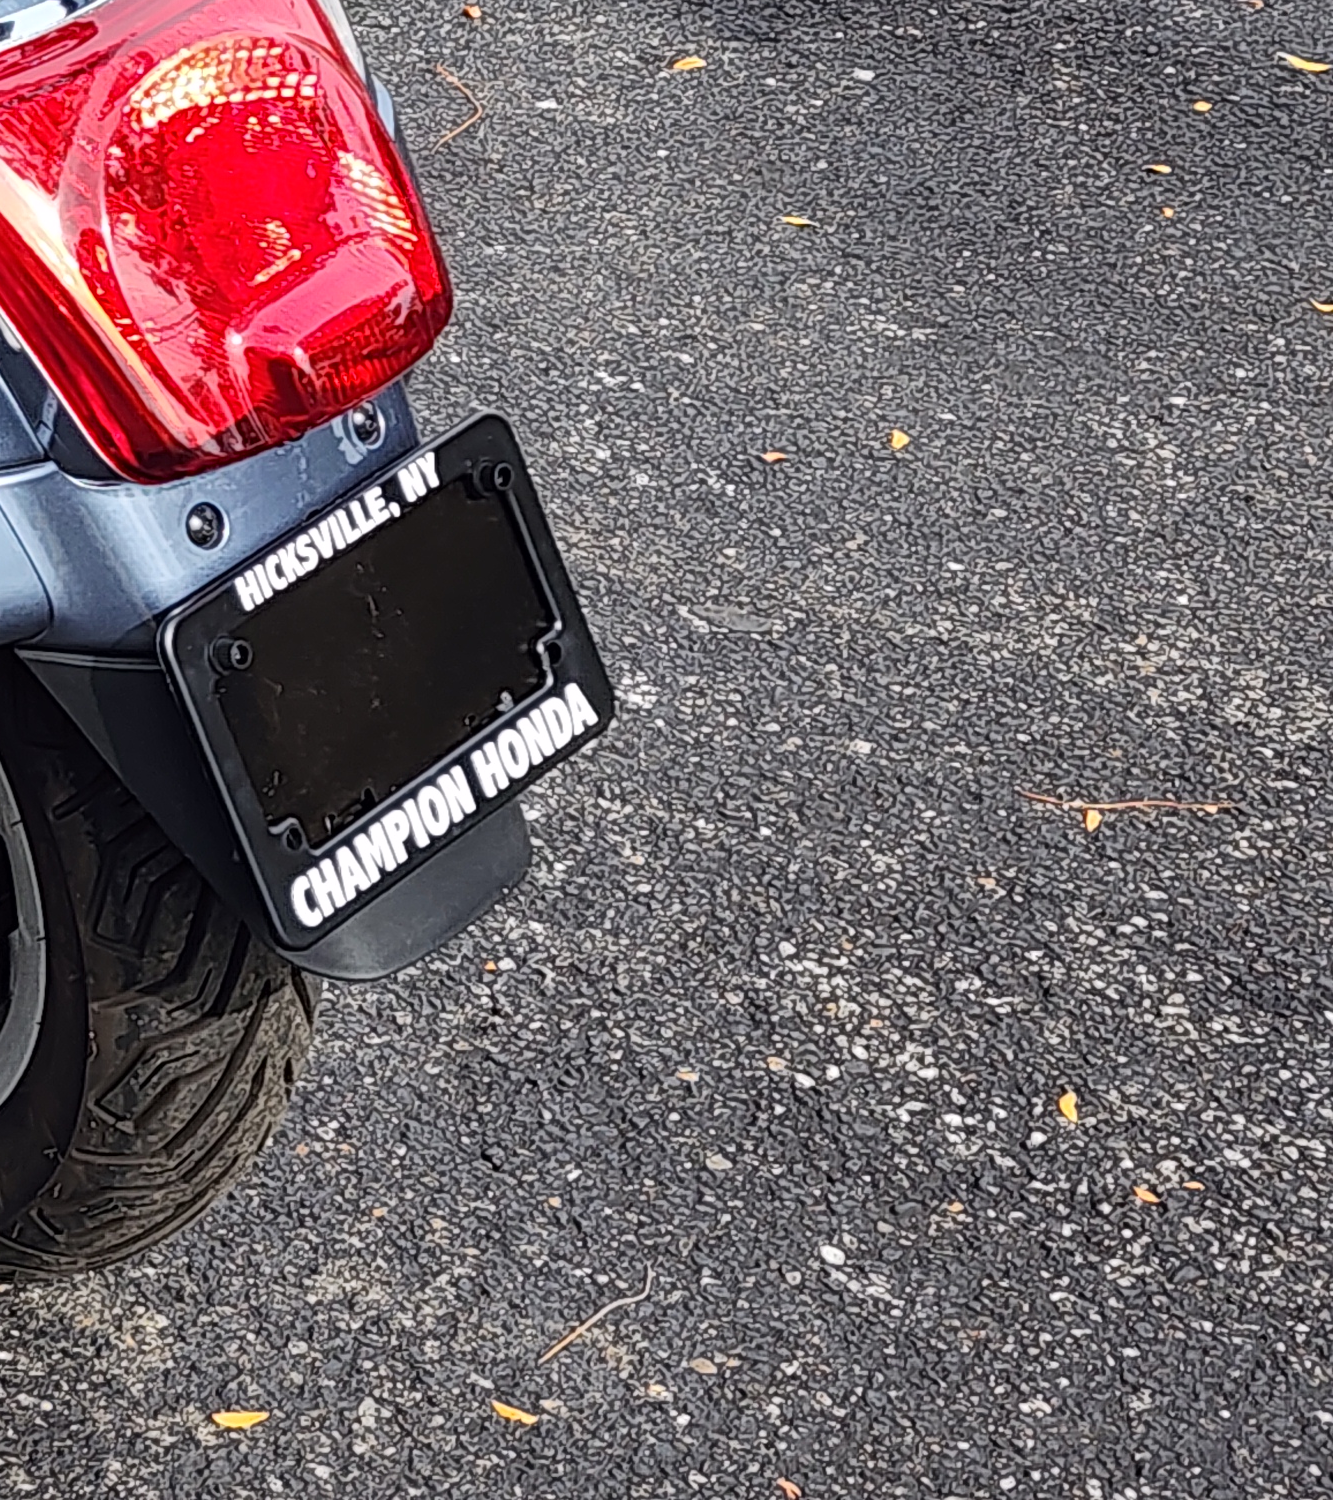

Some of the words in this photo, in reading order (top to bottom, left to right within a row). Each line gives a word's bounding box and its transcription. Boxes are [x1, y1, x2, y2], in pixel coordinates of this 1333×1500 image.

[233, 485, 402, 612] HICKSVILLE,
[396, 451, 442, 503] NY
[289, 762, 478, 929] CHAMPION
[469, 682, 600, 798] HONDA
